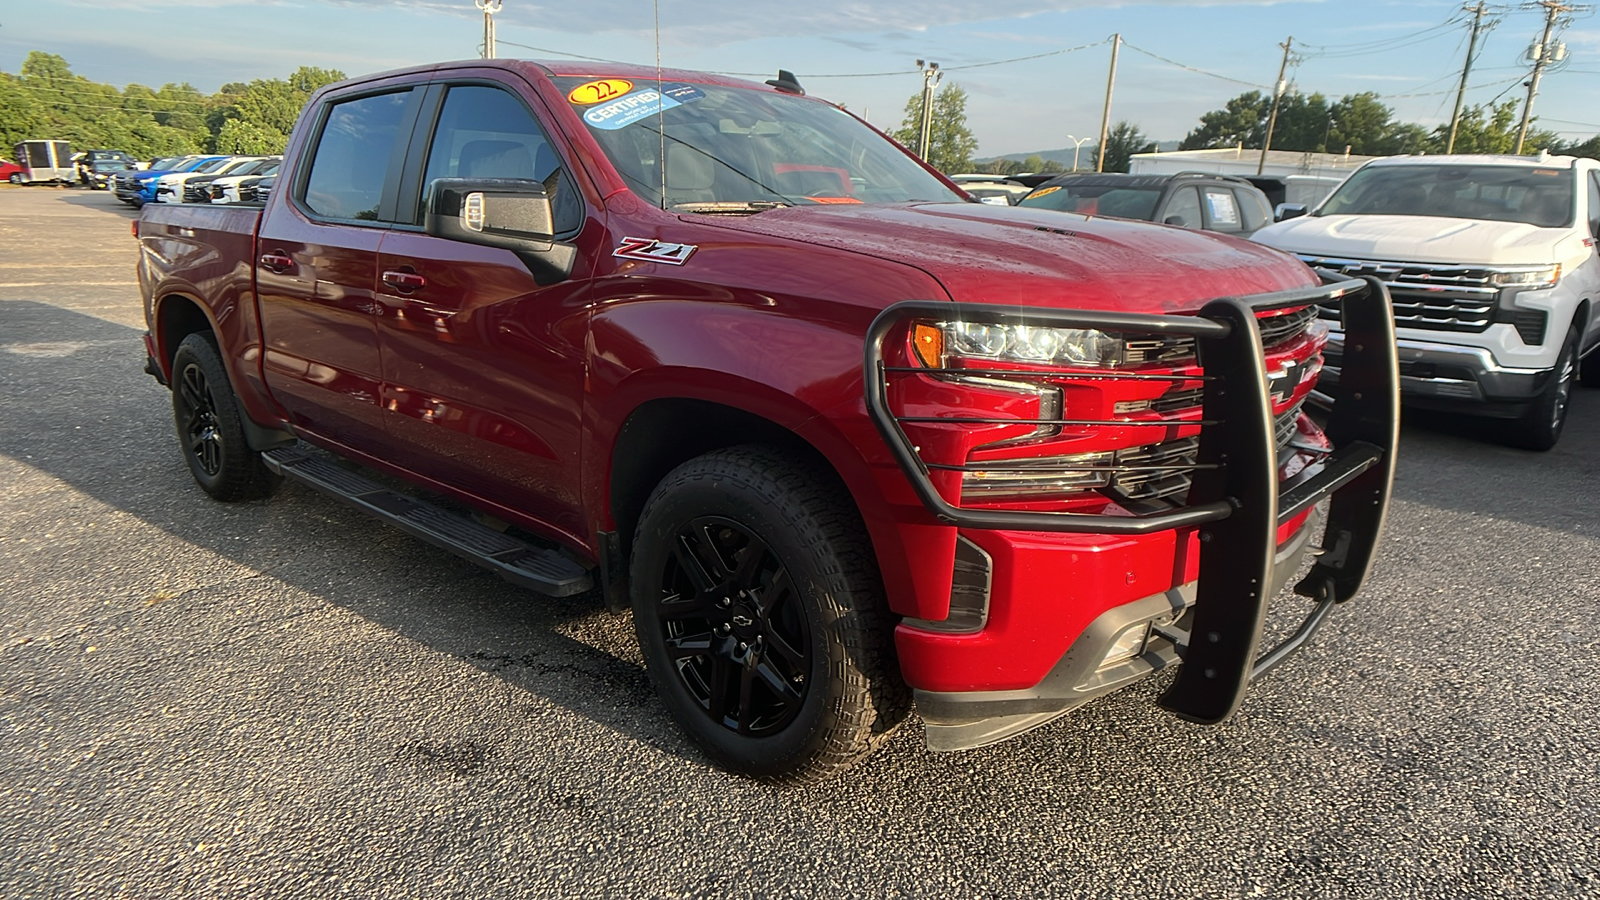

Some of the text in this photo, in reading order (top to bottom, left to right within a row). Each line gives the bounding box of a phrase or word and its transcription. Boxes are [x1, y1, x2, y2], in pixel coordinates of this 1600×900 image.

[587, 82, 618, 100] 22
[587, 92, 660, 122] CERTIFIED
[612, 236, 685, 265] Z71
